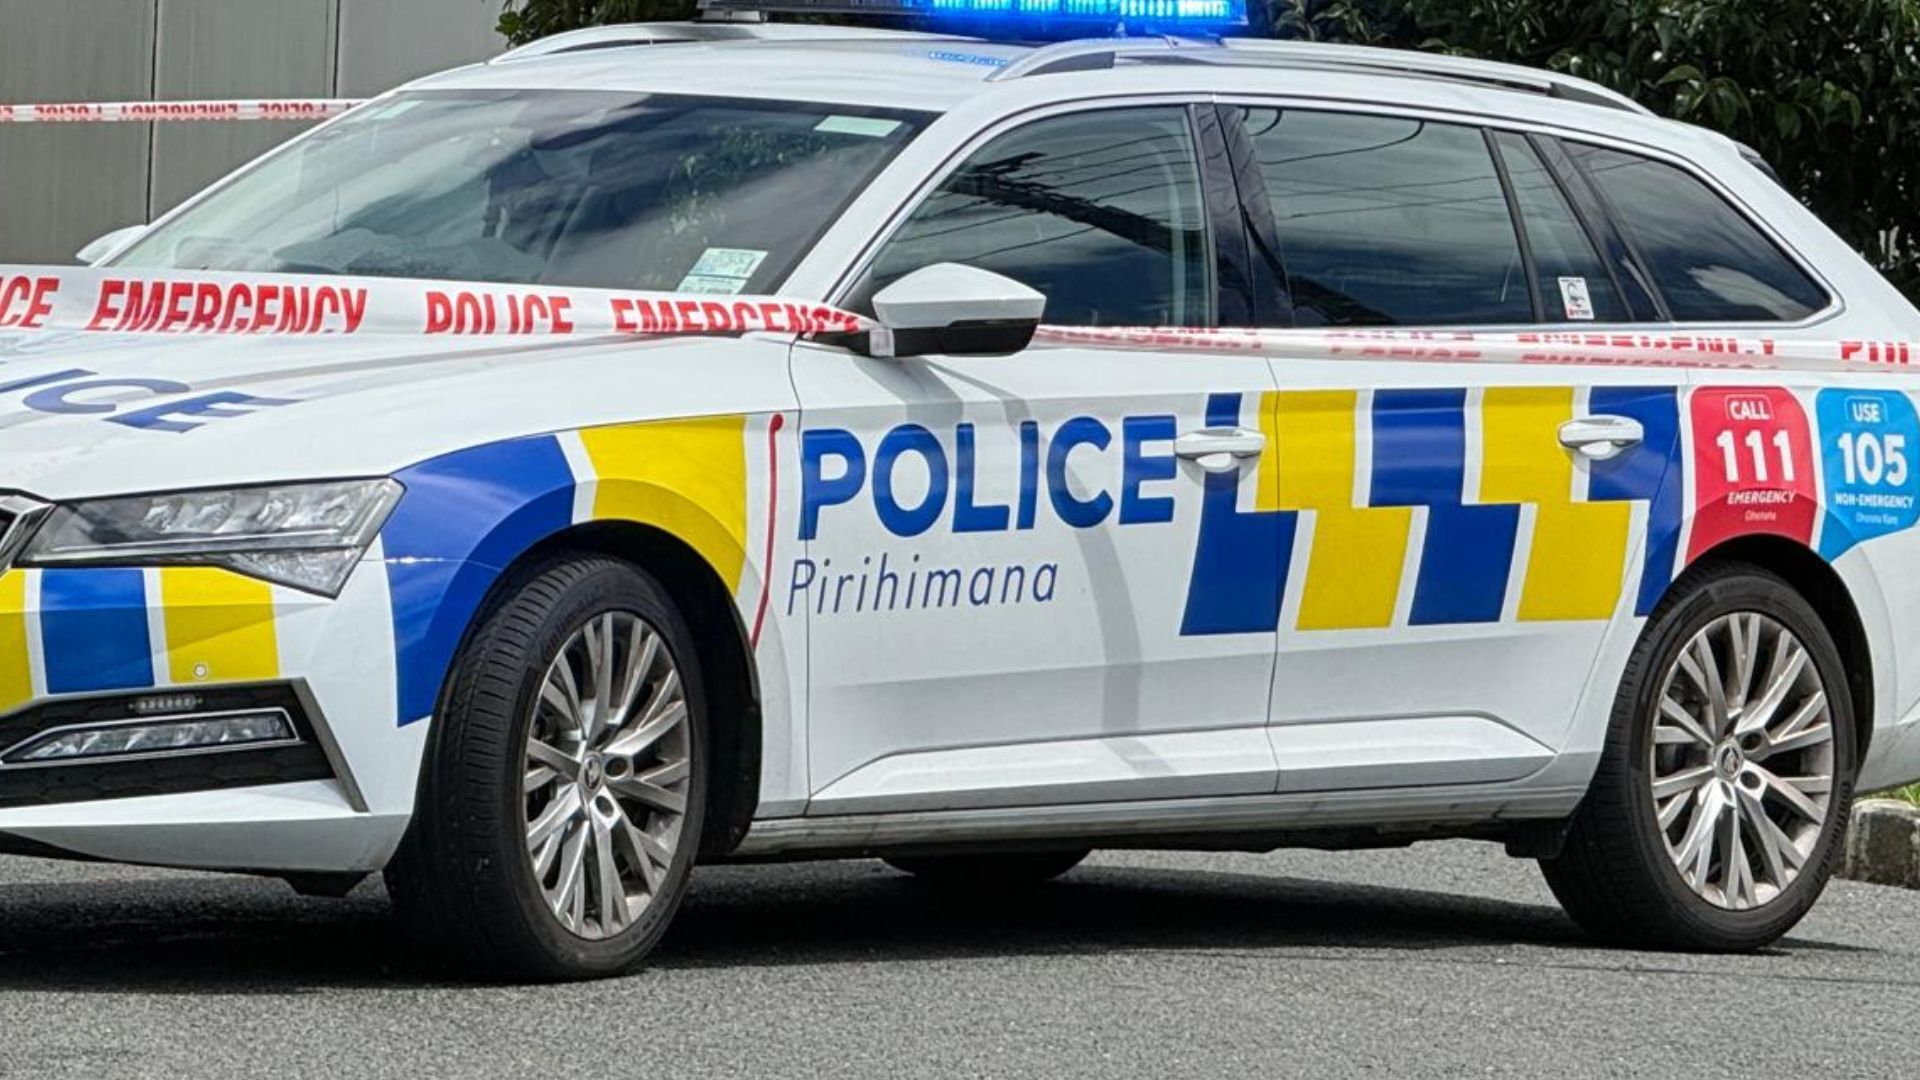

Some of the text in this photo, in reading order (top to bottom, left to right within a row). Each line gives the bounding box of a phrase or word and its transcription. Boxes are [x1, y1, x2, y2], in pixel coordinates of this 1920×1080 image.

[0, 276, 60, 327] CE
[85, 279, 368, 334] EMERGENCY
[424, 292, 573, 334] POLICE
[1729, 400, 1770, 420] CALL
[1852, 402, 1881, 422] USE
[797, 415, 1177, 540] POLICE
[1716, 430, 1794, 482] 111
[1838, 432, 1908, 486] 105
[1727, 491, 1795, 504] EMERGENCY
[1835, 493, 1914, 508] NON-EMERGENCY
[787, 553, 1058, 616] Pirihimana
